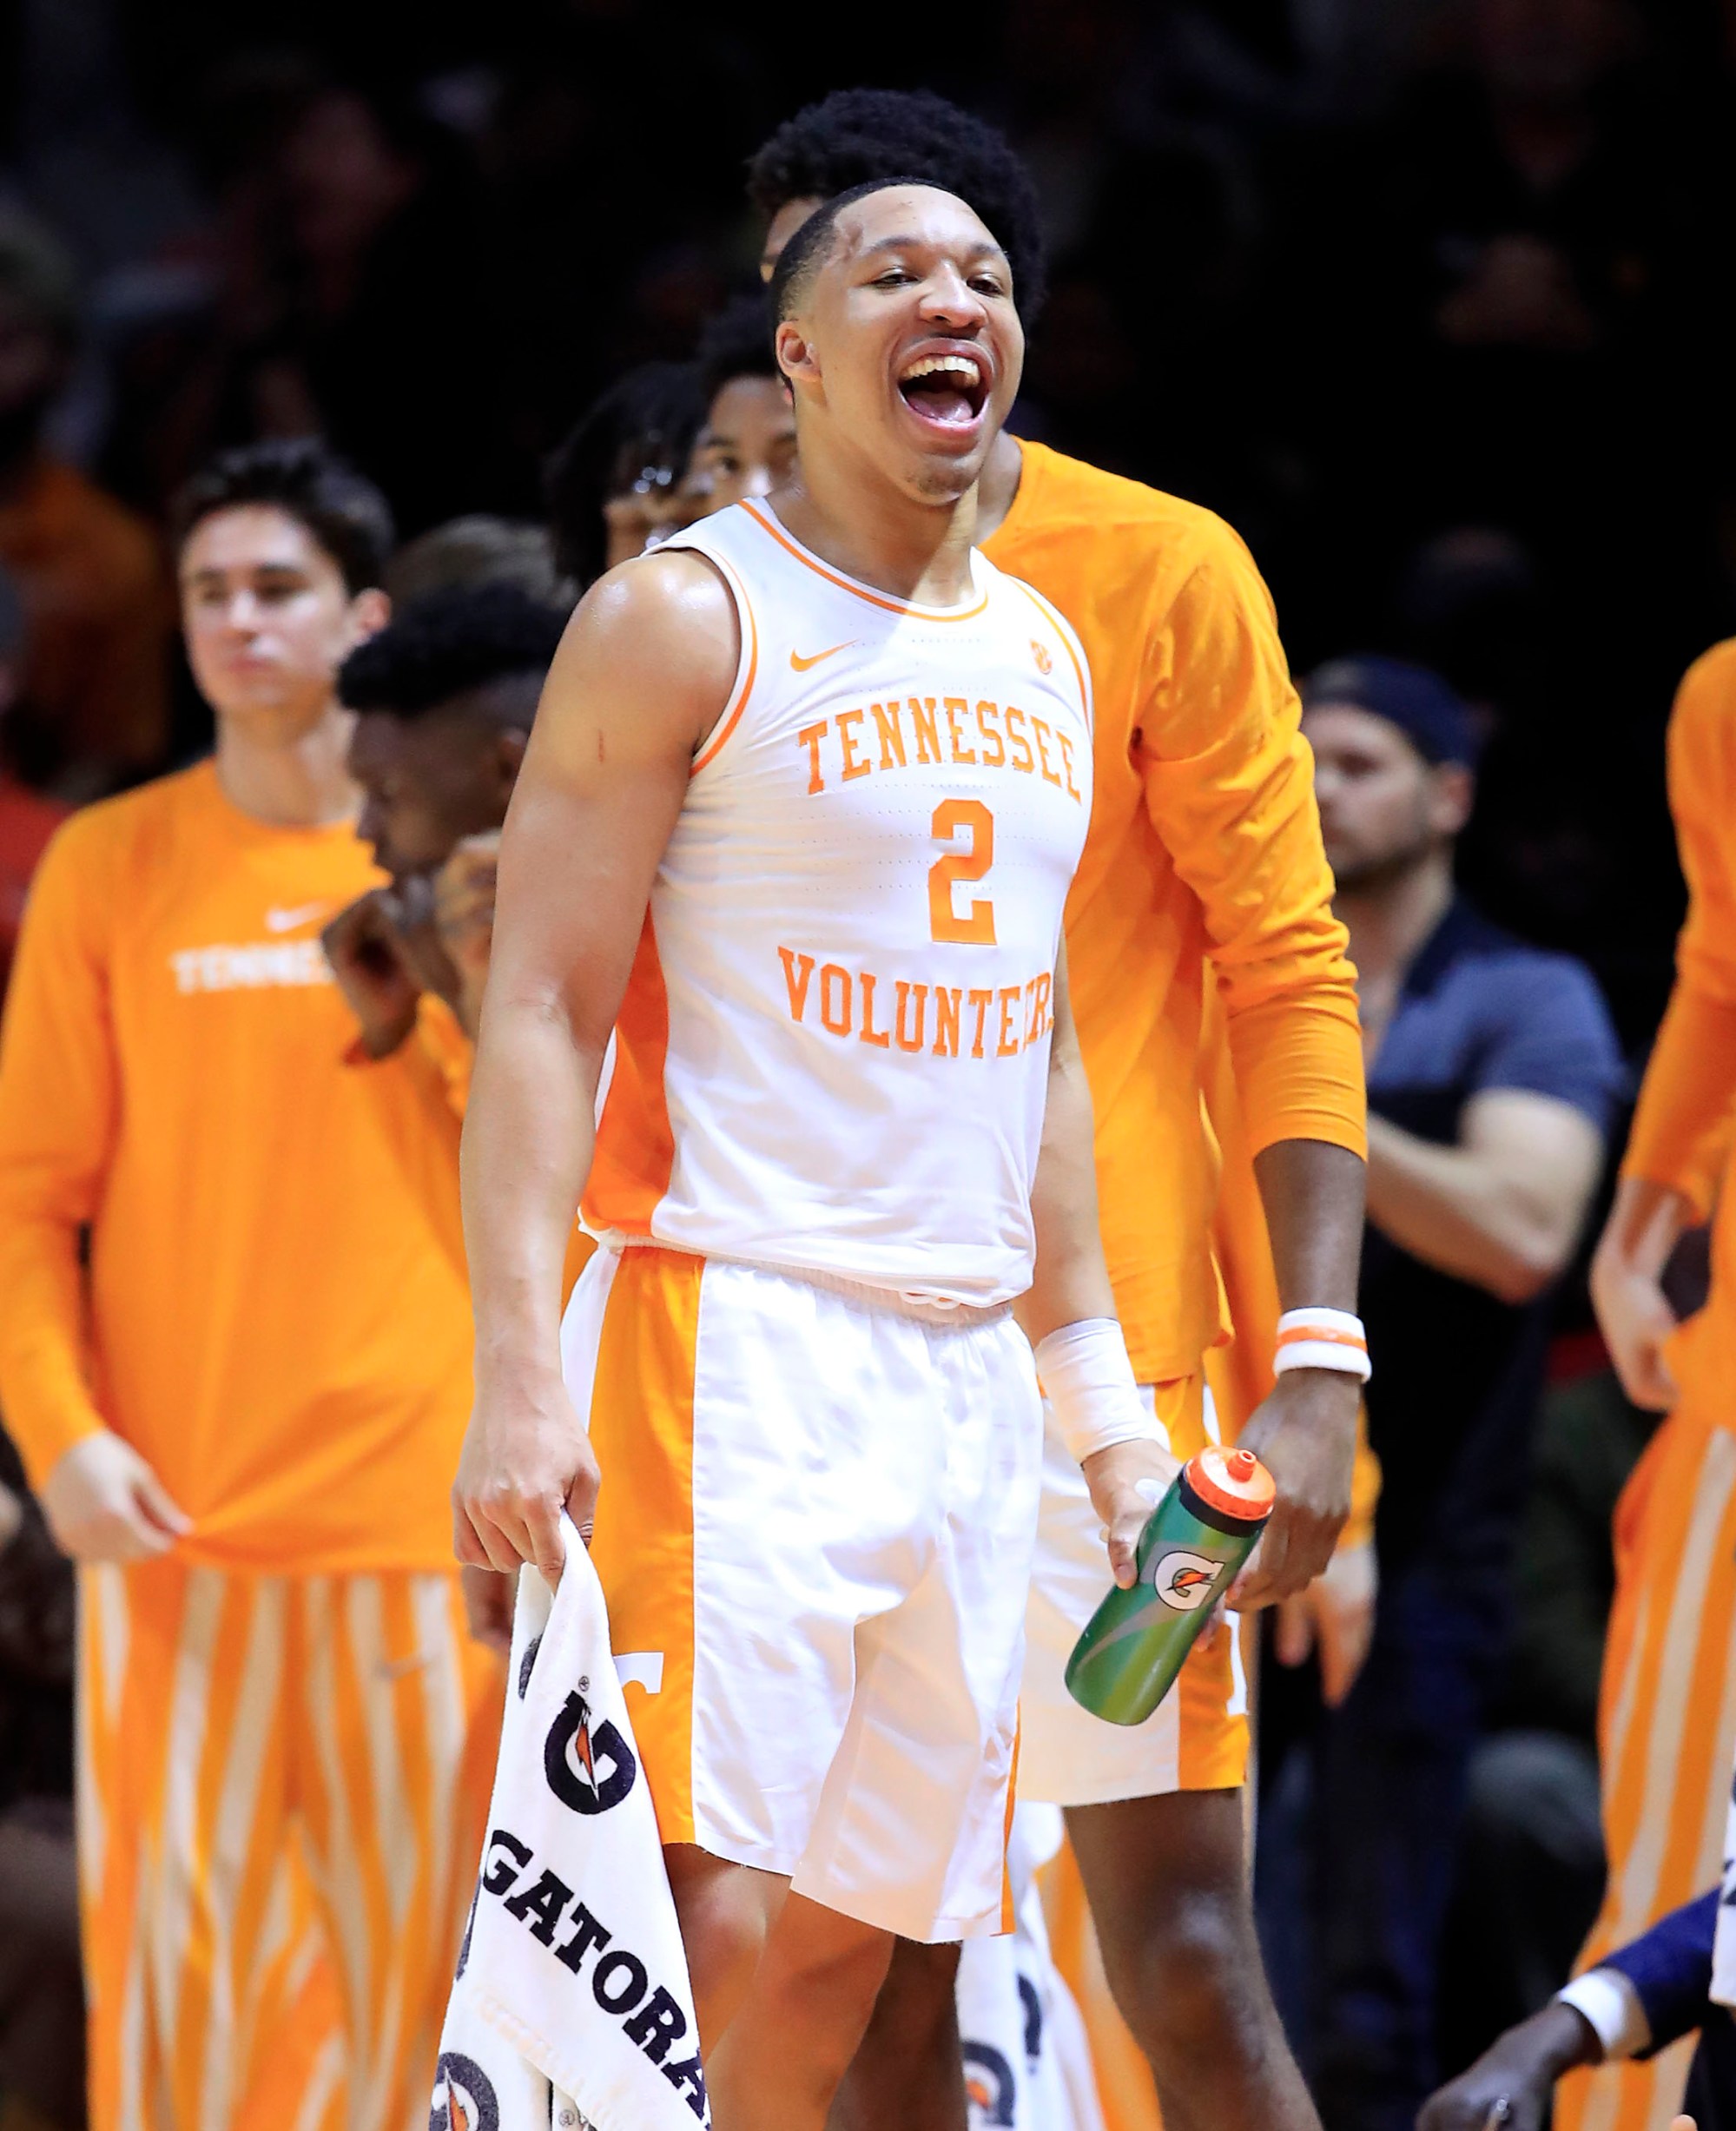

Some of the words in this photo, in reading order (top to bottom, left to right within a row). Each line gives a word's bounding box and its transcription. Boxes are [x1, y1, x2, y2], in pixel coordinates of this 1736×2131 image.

[797, 697, 1082, 805] TENNESSEE
[927, 799, 998, 946] 2
[544, 1689, 637, 1816] G
[483, 1829, 712, 2131] GATORA
